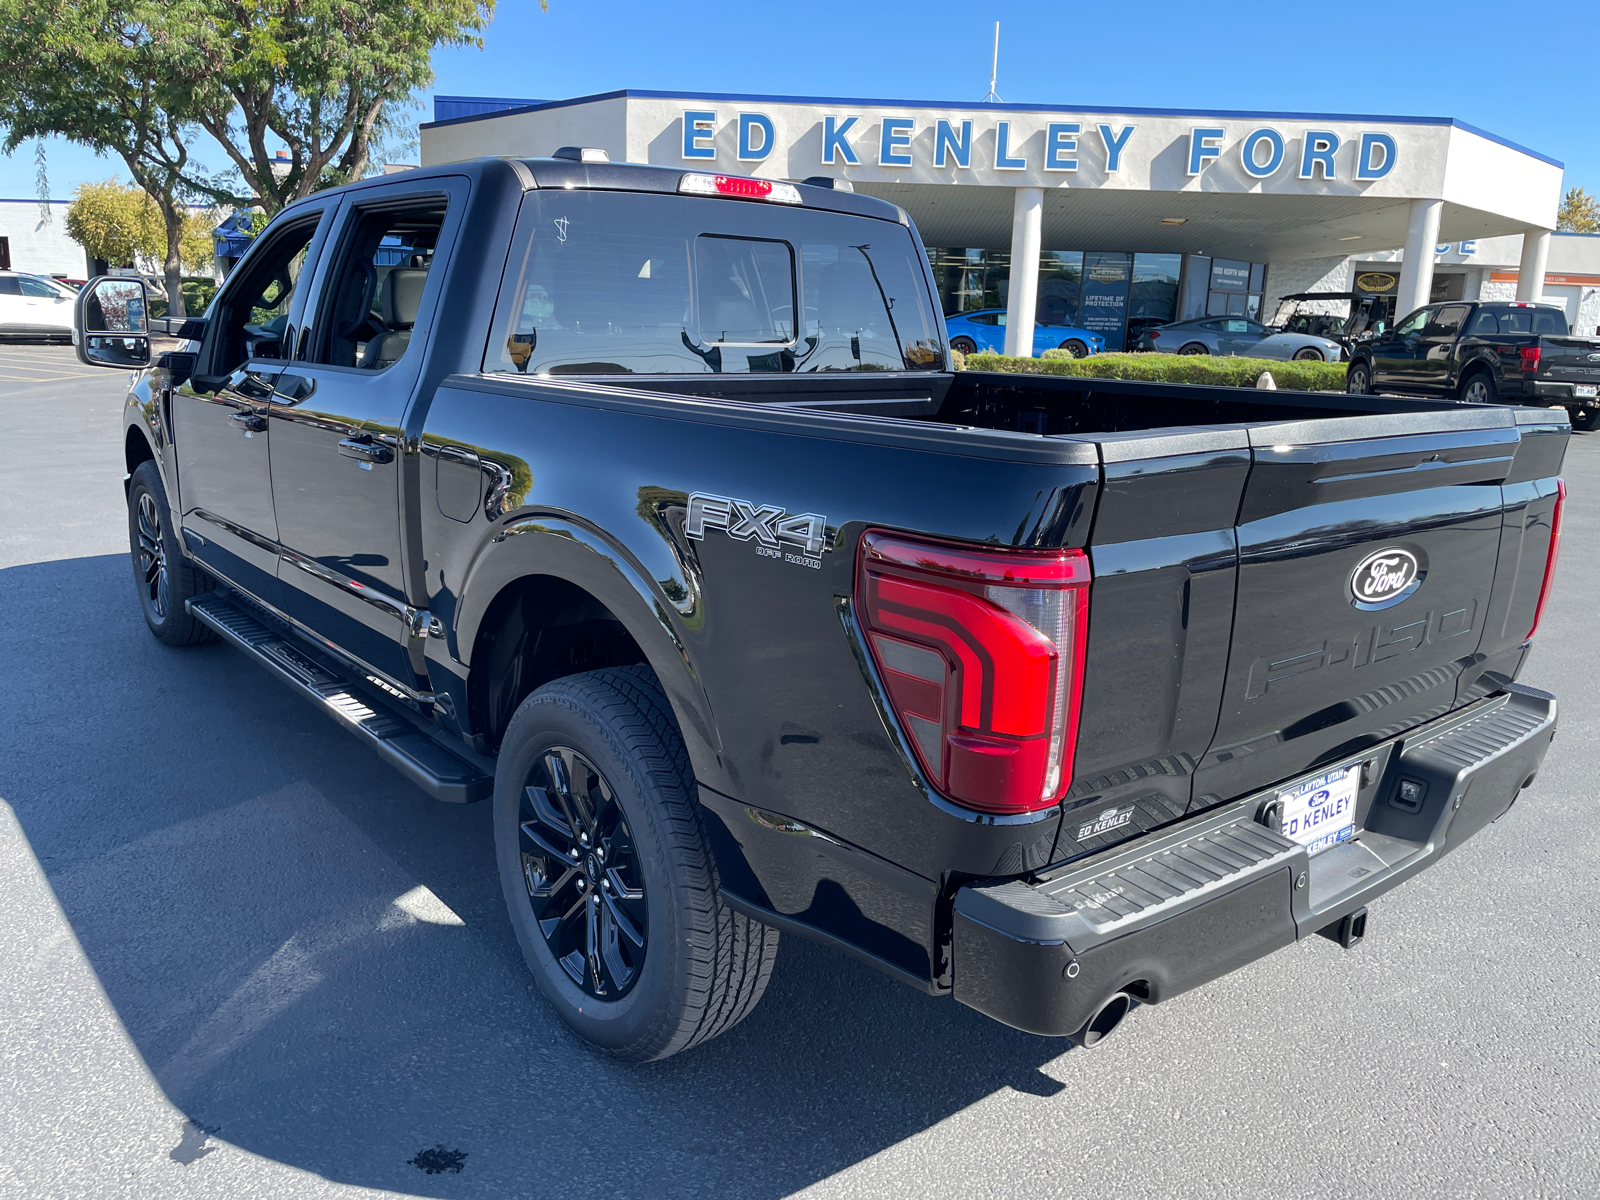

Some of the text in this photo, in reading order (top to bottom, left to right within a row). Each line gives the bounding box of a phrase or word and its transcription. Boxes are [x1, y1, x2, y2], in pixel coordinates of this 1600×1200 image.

[682, 109, 1398, 181] ED KENLEY FORD
[1223, 268, 1238, 276] NORTH
[685, 491, 827, 559] FX4
[755, 546, 821, 570] OFF ROAD
[1363, 557, 1409, 595] Ford
[1245, 598, 1478, 701] F-150
[1327, 769, 1345, 783] UTAH
[1078, 810, 1133, 838] ED KENLEY
[1303, 794, 1352, 830] KENLEY
[1307, 831, 1339, 856] KENLEY
